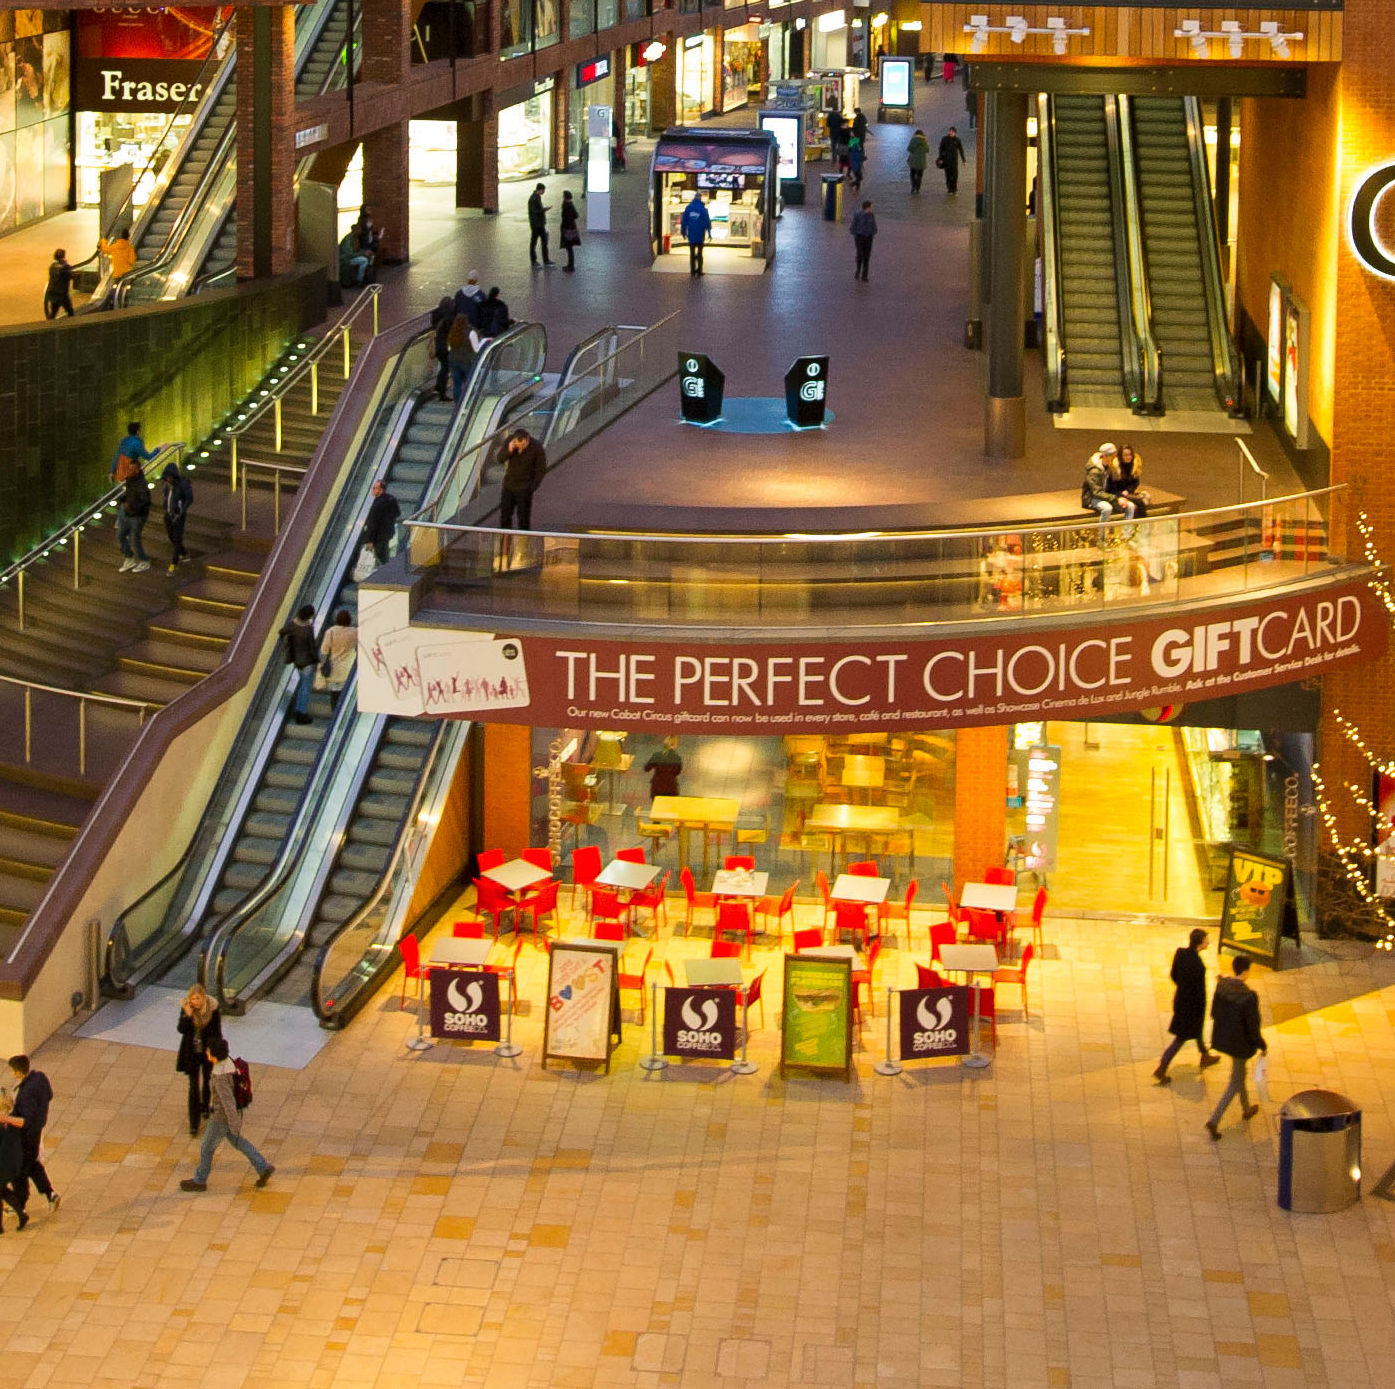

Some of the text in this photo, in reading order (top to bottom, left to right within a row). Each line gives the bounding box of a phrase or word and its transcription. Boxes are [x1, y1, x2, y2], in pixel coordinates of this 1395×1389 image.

[100, 70, 203, 102] Fraser
[555, 595, 1361, 706] THE PERFECT CHOICE GIFTCARD
[567, 706, 588, 717] Our
[589, 708, 608, 718] new
[610, 709, 641, 720] Cabot
[642, 710, 672, 722] Circus
[674, 711, 710, 724] giftcard
[711, 713, 730, 723] can
[732, 714, 753, 723] now
[755, 712, 769, 723] be
[770, 712, 793, 723] used
[794, 712, 804, 722] in
[805, 713, 830, 724] every
[881, 709, 900, 721] and
[952, 709, 963, 717] as
[965, 705, 983, 716] well
[984, 705, 995, 715] as
[996, 701, 1040, 714] Showcase
[1041, 698, 1076, 710] Cinema
[1077, 695, 1089, 706] de
[1090, 694, 1105, 704] Lux
[1106, 691, 1124, 703] and
[1124, 687, 1150, 701] Jungle
[1185, 679, 1203, 691] Ask
[1205, 677, 1215, 687] at
[1216, 674, 1231, 685] the
[1233, 666, 1273, 682] Customer
[1274, 659, 1303, 674] Service
[1304, 653, 1323, 667] Desk
[1323, 650, 1335, 662] for
[1232, 858, 1284, 887] VIP
[444, 1012, 488, 1026] SOHO
[677, 1029, 722, 1044] SOHO
[913, 1028, 957, 1044] SOHO
